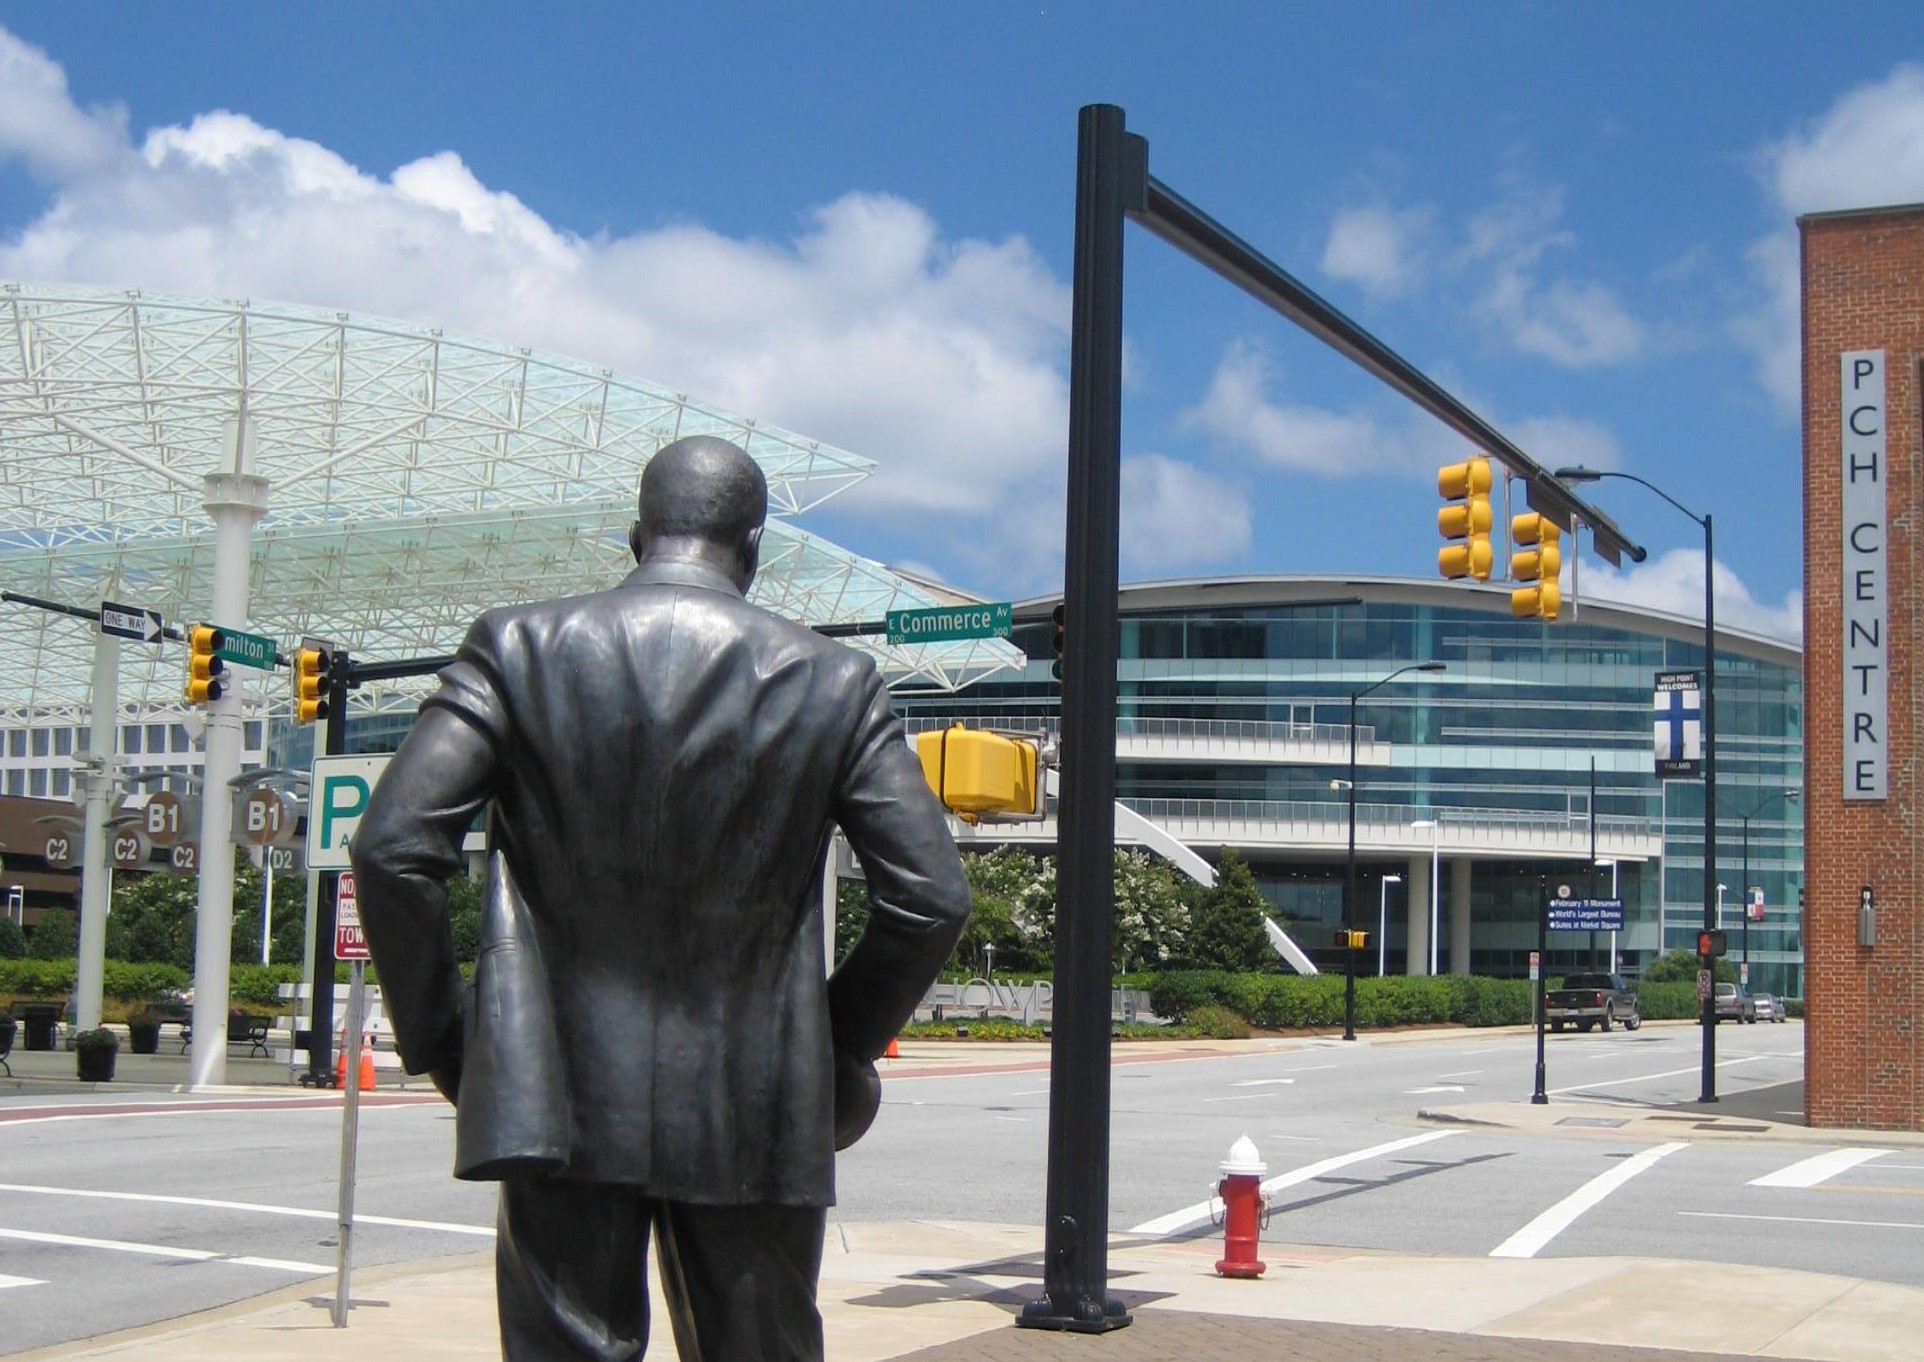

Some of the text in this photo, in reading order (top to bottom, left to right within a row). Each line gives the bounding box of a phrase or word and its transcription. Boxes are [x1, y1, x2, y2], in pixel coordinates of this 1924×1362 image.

[1849, 359, 1880, 792] PCH CENTRE
[105, 611, 147, 631] ONE WAY
[889, 606, 1008, 634] E Commerce Av
[889, 627, 1009, 644] 200 300
[224, 634, 264, 660] milton
[1656, 682, 1699, 691] WELCOMES
[1676, 673, 1694, 682] POINT
[148, 803, 179, 833] B1
[247, 801, 280, 832] B1
[46, 838, 68, 860] C2
[114, 838, 138, 860] C2
[172, 845, 194, 868] C2
[273, 849, 293, 869] D2
